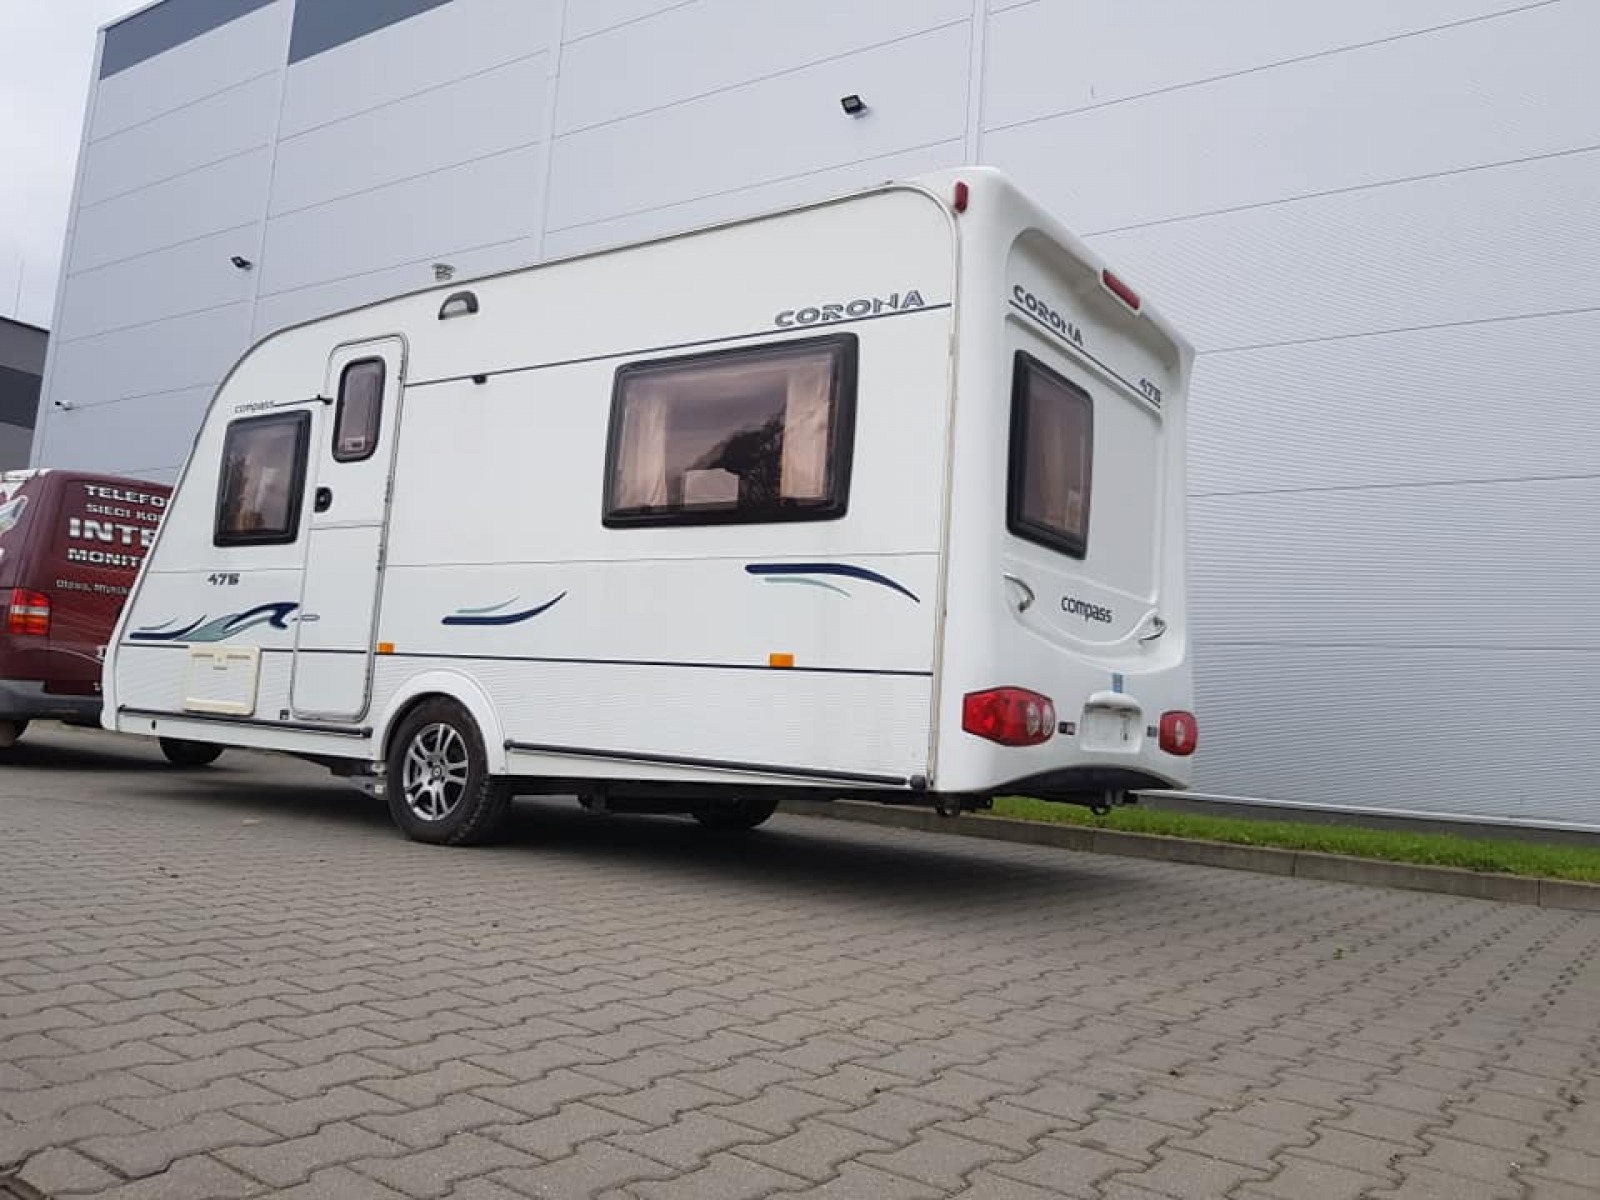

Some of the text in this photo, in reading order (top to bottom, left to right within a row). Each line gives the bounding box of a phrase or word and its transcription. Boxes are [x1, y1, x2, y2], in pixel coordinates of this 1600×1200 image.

[775, 290, 925, 327] CORONA
[1013, 284, 1083, 346] CORONA
[234, 400, 274, 414] compass
[86, 503, 131, 518] SIECI
[68, 547, 141, 567] MONIT
[207, 572, 241, 586] 475
[1060, 596, 1113, 623] compass
